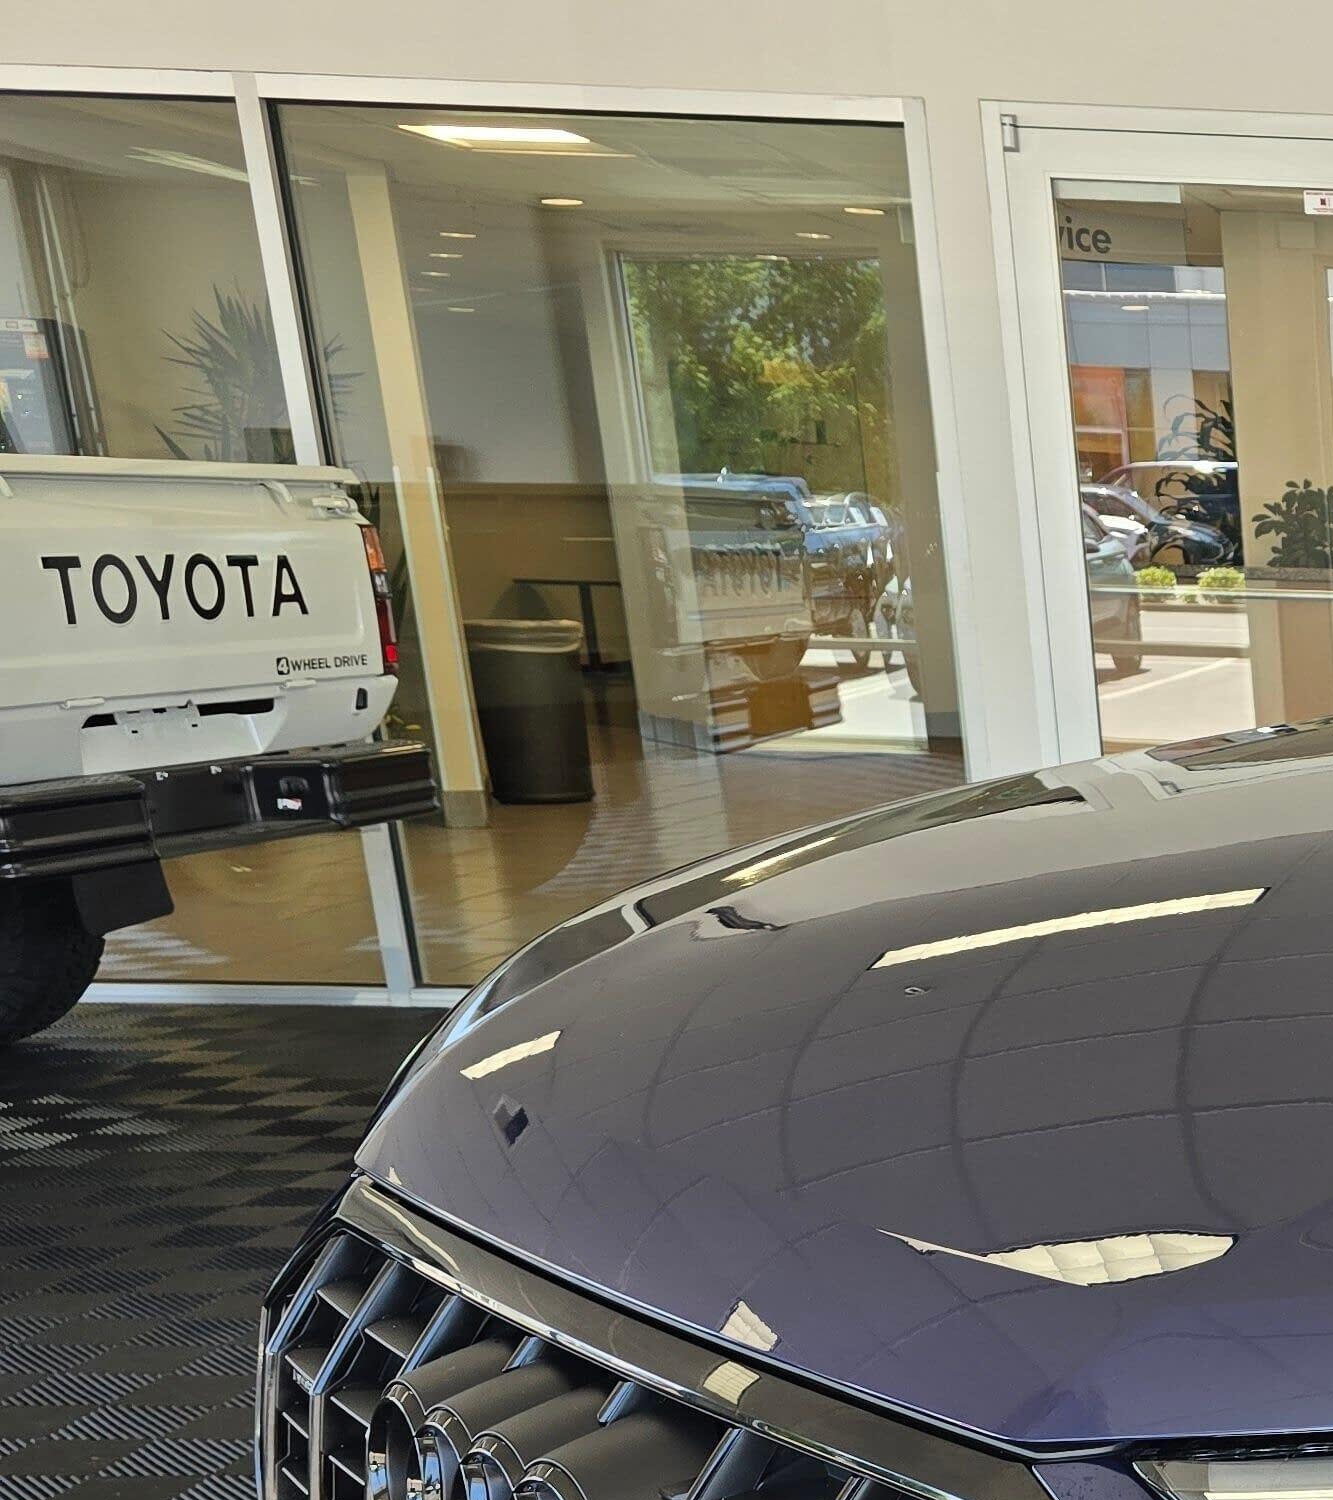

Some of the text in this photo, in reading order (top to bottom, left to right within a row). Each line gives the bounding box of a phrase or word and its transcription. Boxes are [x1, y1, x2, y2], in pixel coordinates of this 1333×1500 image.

[40, 553, 309, 625] TOYOTA
[291, 657, 331, 671] WHEEL
[334, 654, 368, 668] DRIVE
